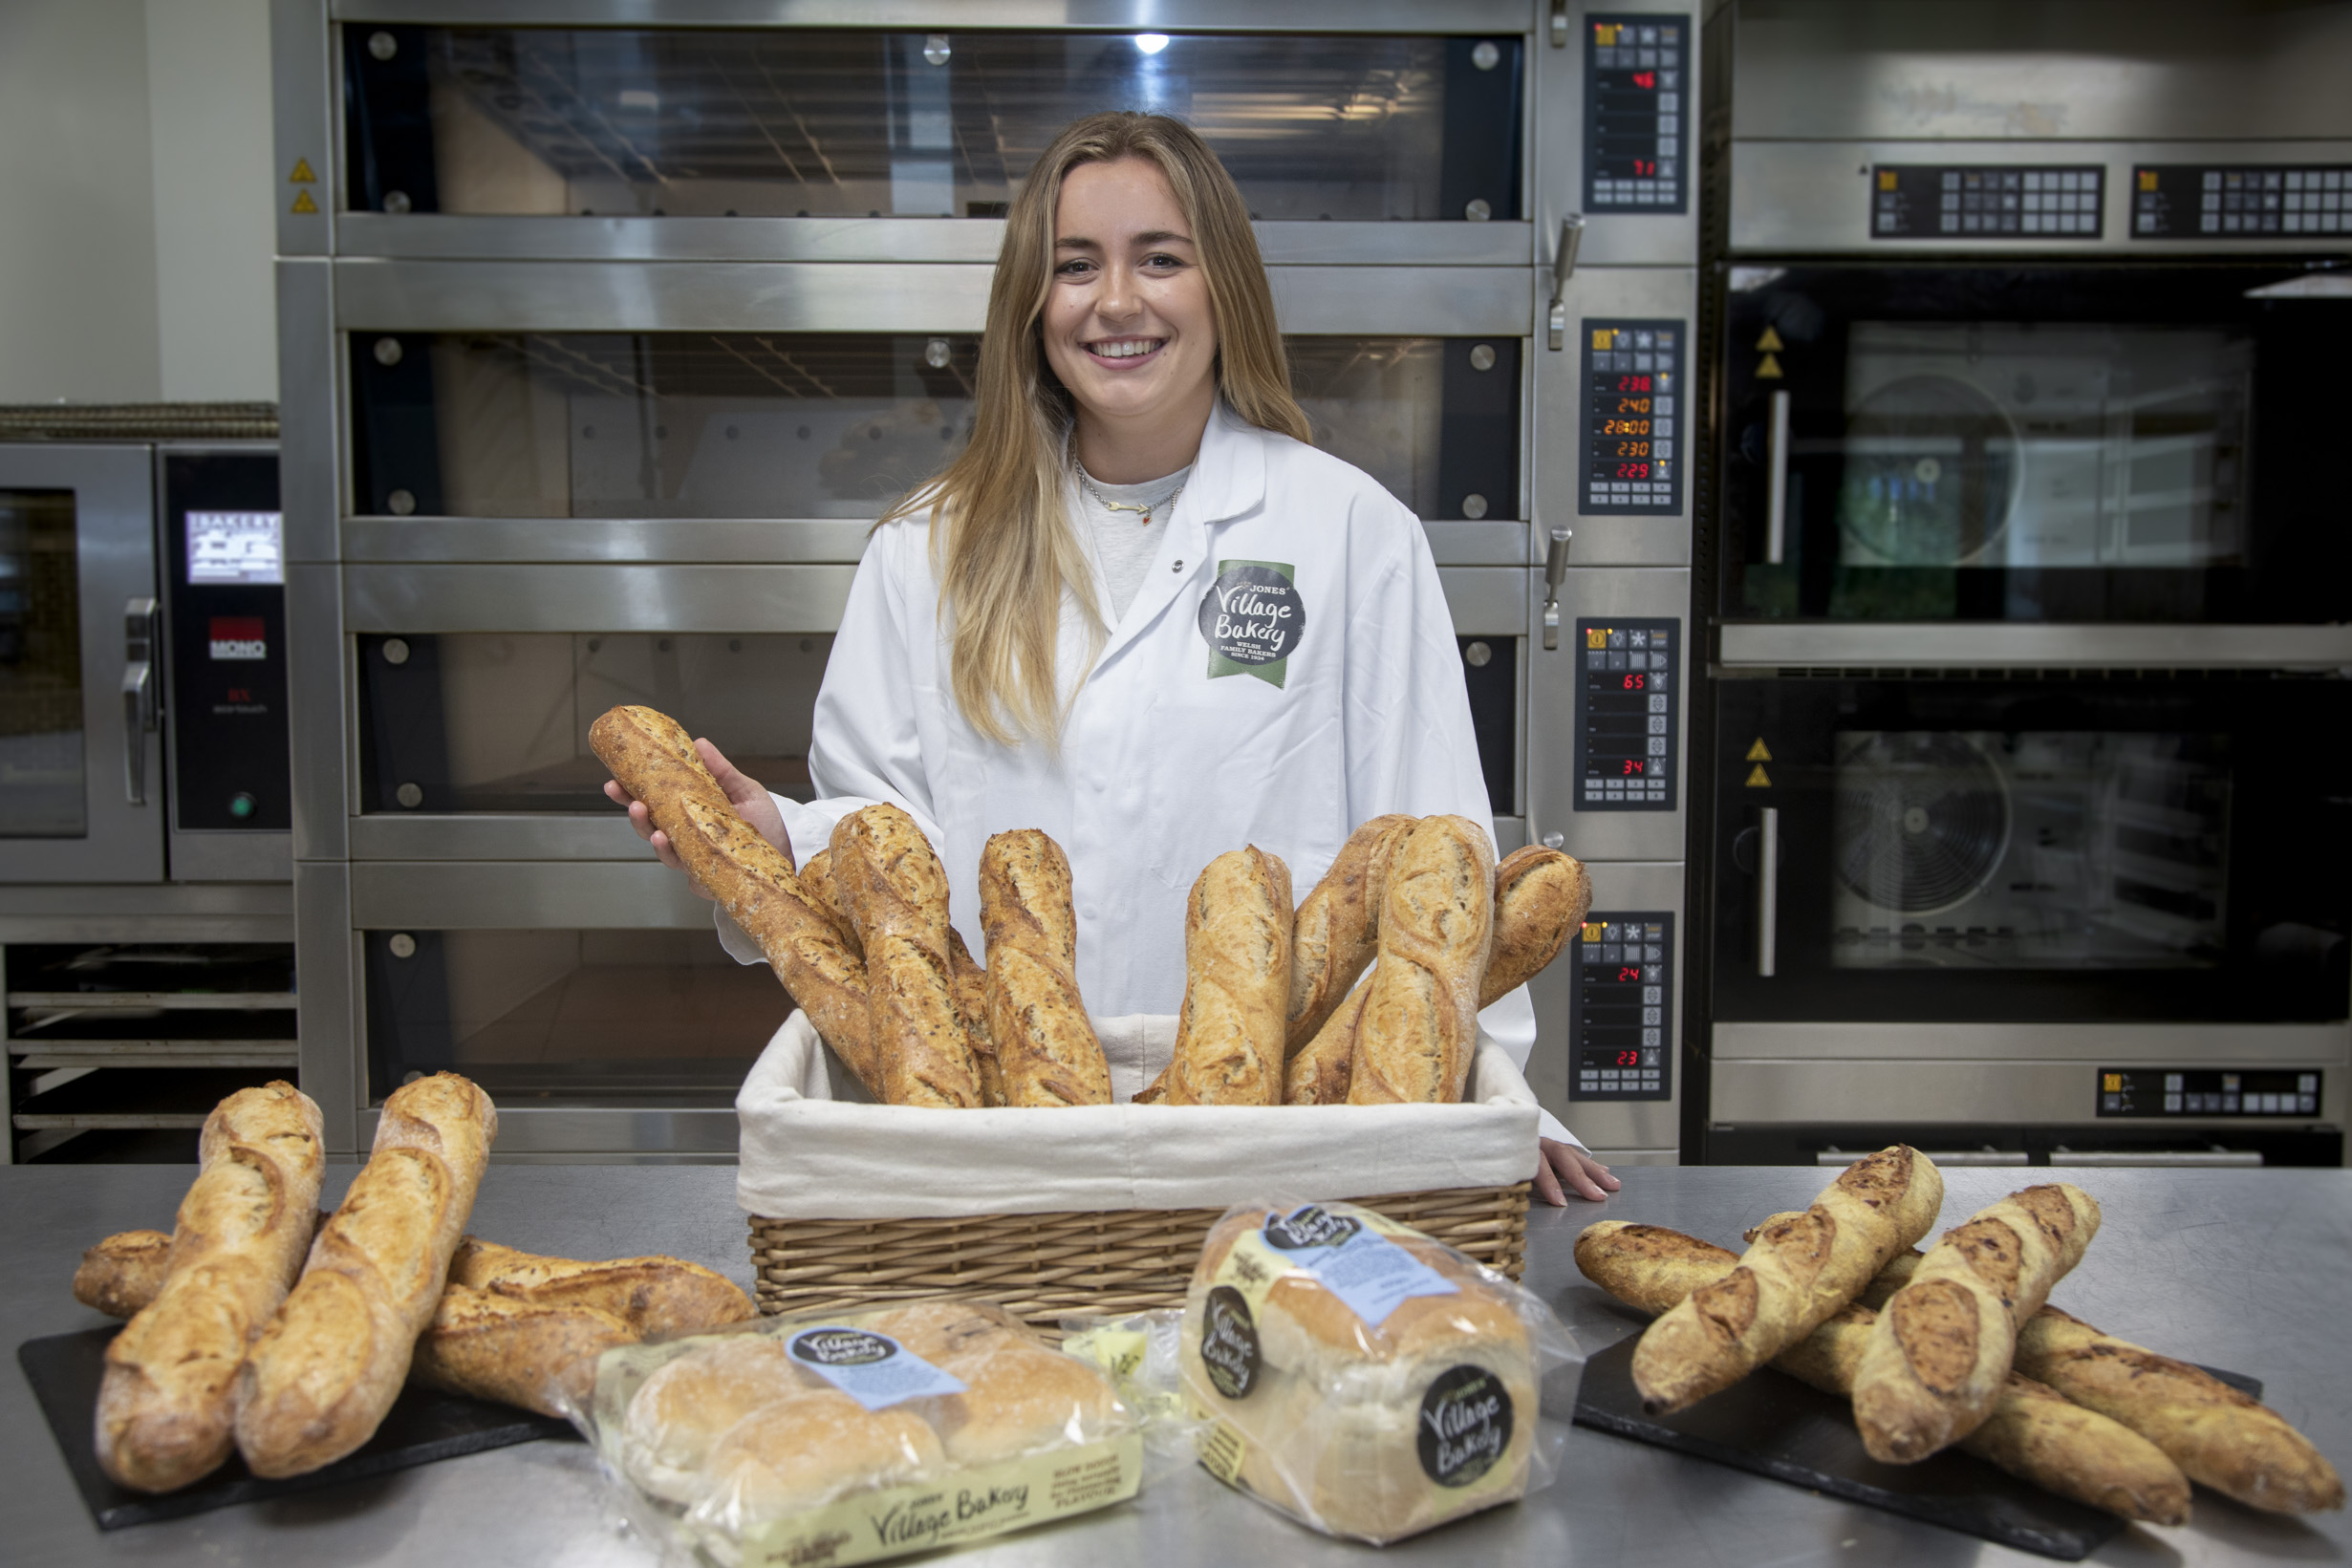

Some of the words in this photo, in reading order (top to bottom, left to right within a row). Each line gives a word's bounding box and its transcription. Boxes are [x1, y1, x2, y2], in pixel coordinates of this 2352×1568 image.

[1618, 397, 1651, 413] 240
[1617, 441, 1649, 457] 230
[1617, 462, 1649, 479] 229
[1216, 585, 1291, 629] Village
[1215, 613, 1285, 652] Bakery
[1219, 645, 1246, 654] FAMILY
[1247, 649, 1277, 658] BAKERS
[1236, 641, 1262, 651] WELSH
[1623, 675, 1645, 690] 65
[1623, 760, 1644, 775] 34
[1618, 967, 1640, 982] 24
[1616, 1051, 1638, 1065] 23
[1421, 1395, 1500, 1441] Village
[1436, 1426, 1501, 1475] Bakery
[871, 1501, 950, 1546] Village
[957, 1484, 1029, 1520] Bakery
